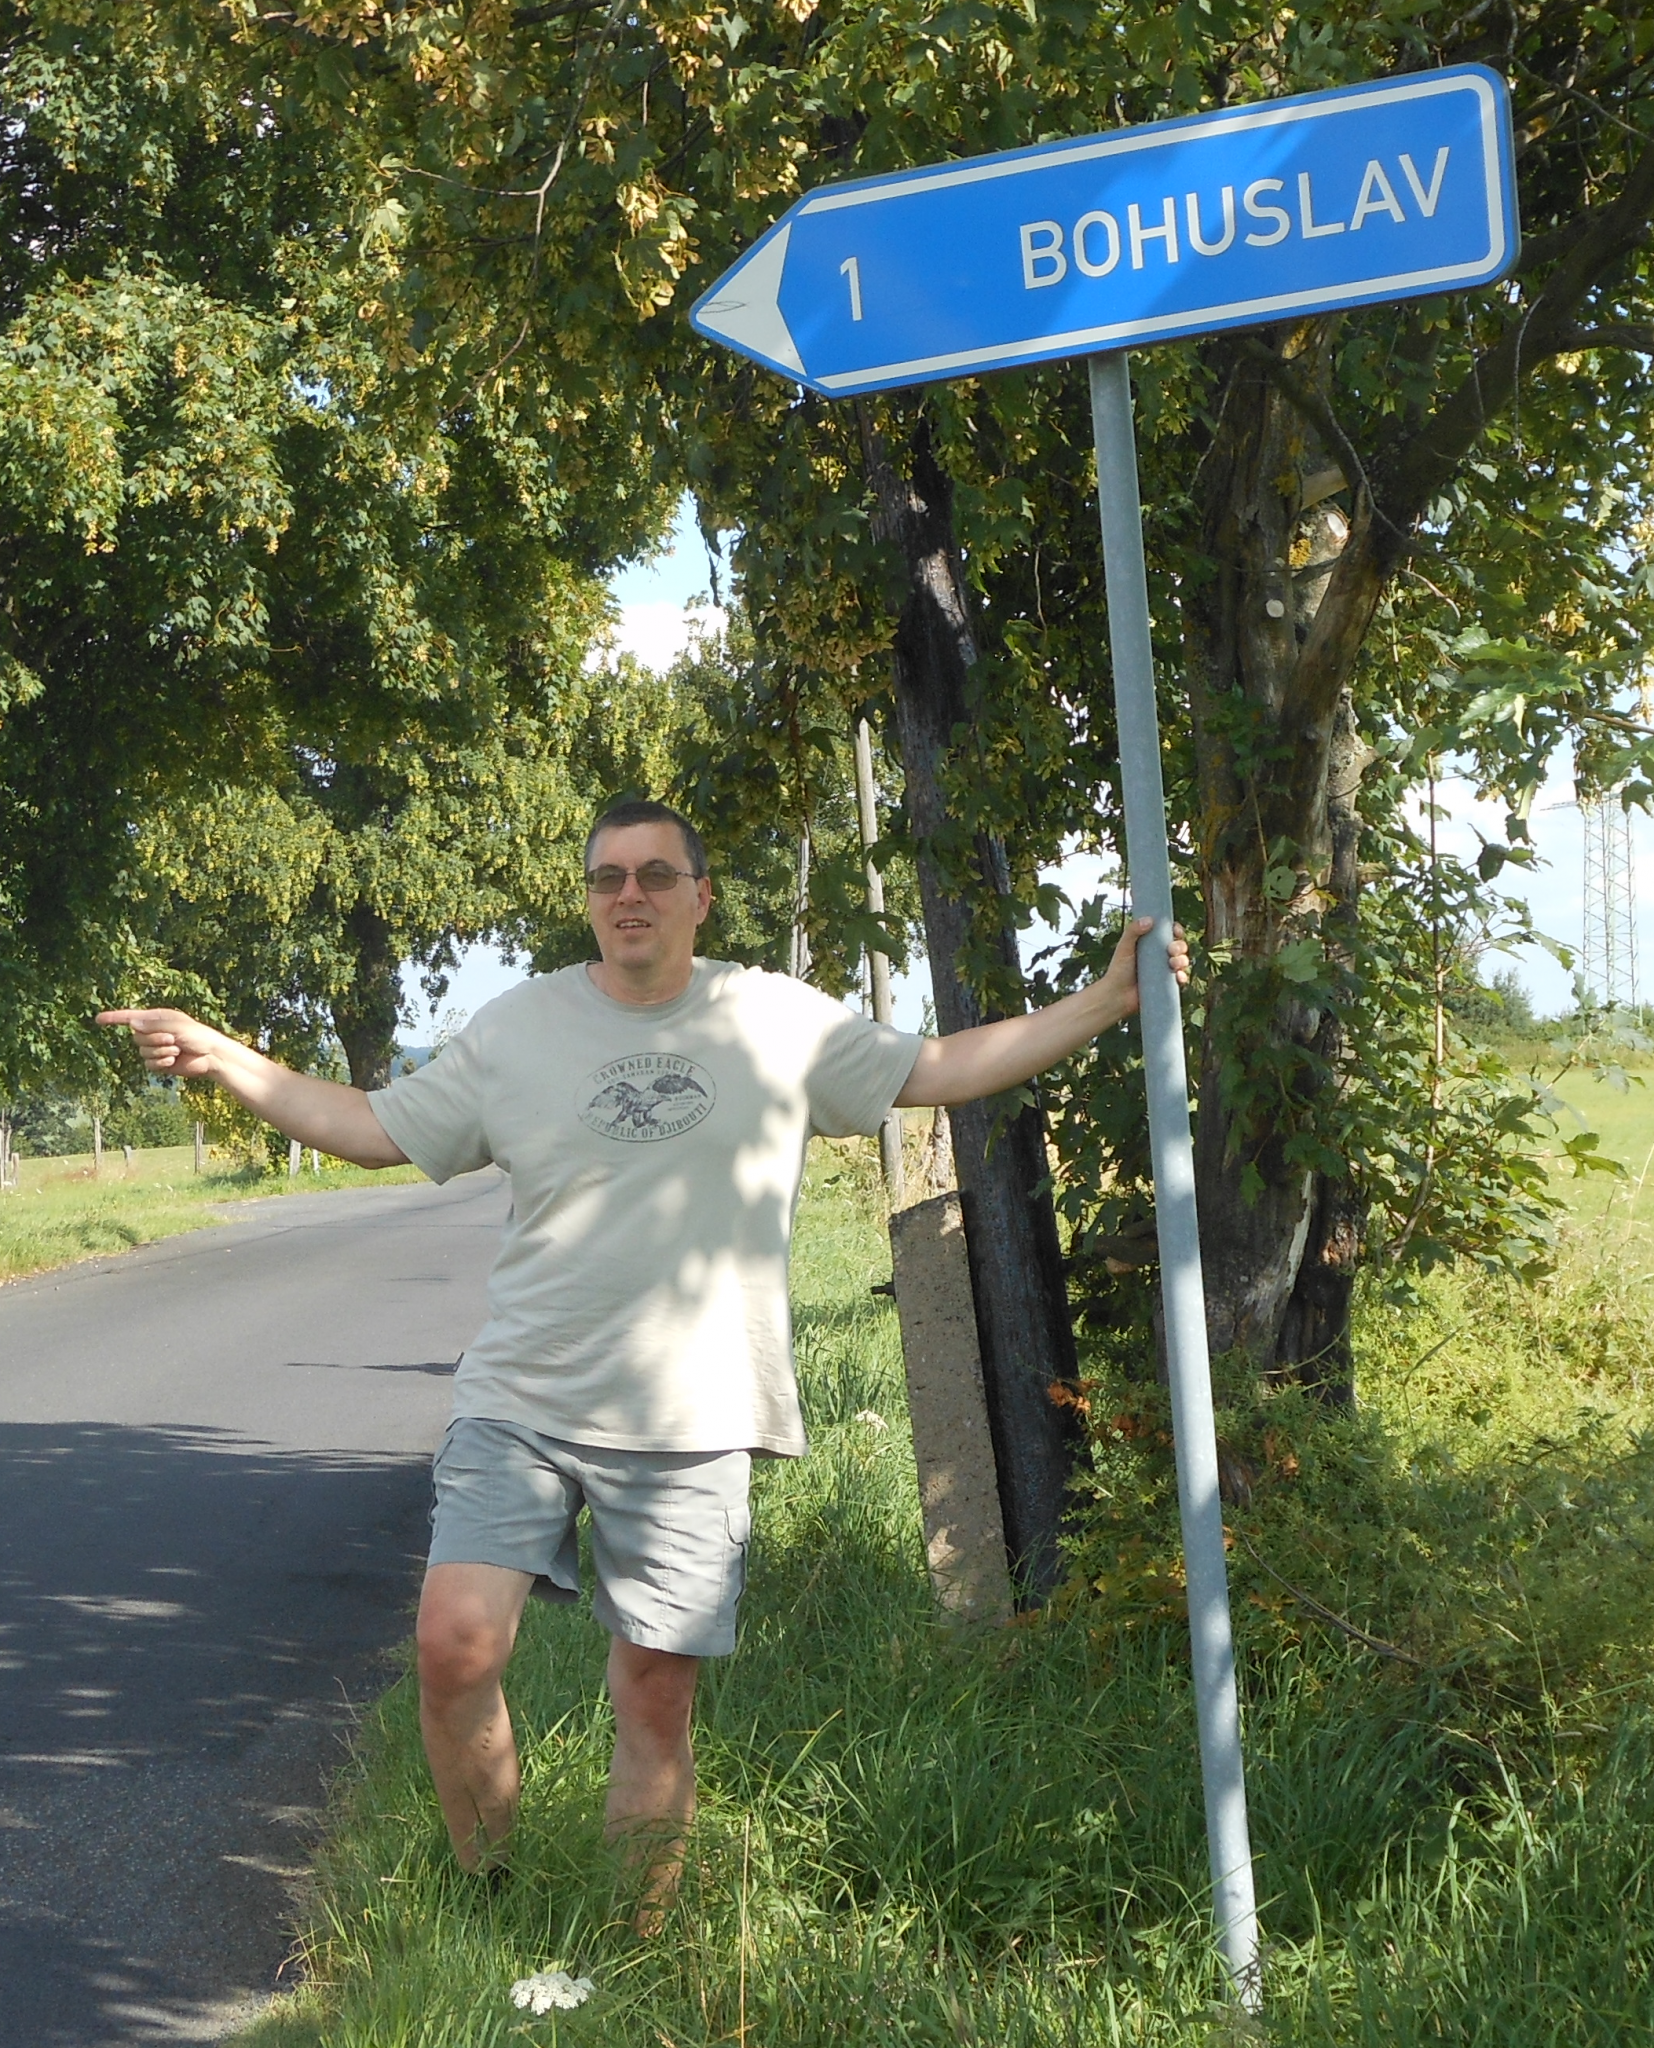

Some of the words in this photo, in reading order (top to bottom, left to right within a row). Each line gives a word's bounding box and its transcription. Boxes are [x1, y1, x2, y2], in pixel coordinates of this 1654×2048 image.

[839, 256, 863, 322] 1
[1019, 146, 1451, 291] BOHUSLAV
[592, 1057, 652, 1085] CROWNED
[656, 1056, 696, 1077] EAGLE
[584, 1112, 638, 1139] REPUBLIC
[641, 1127, 655, 1139] OF
[659, 1102, 708, 1137] DJIBOUTI
